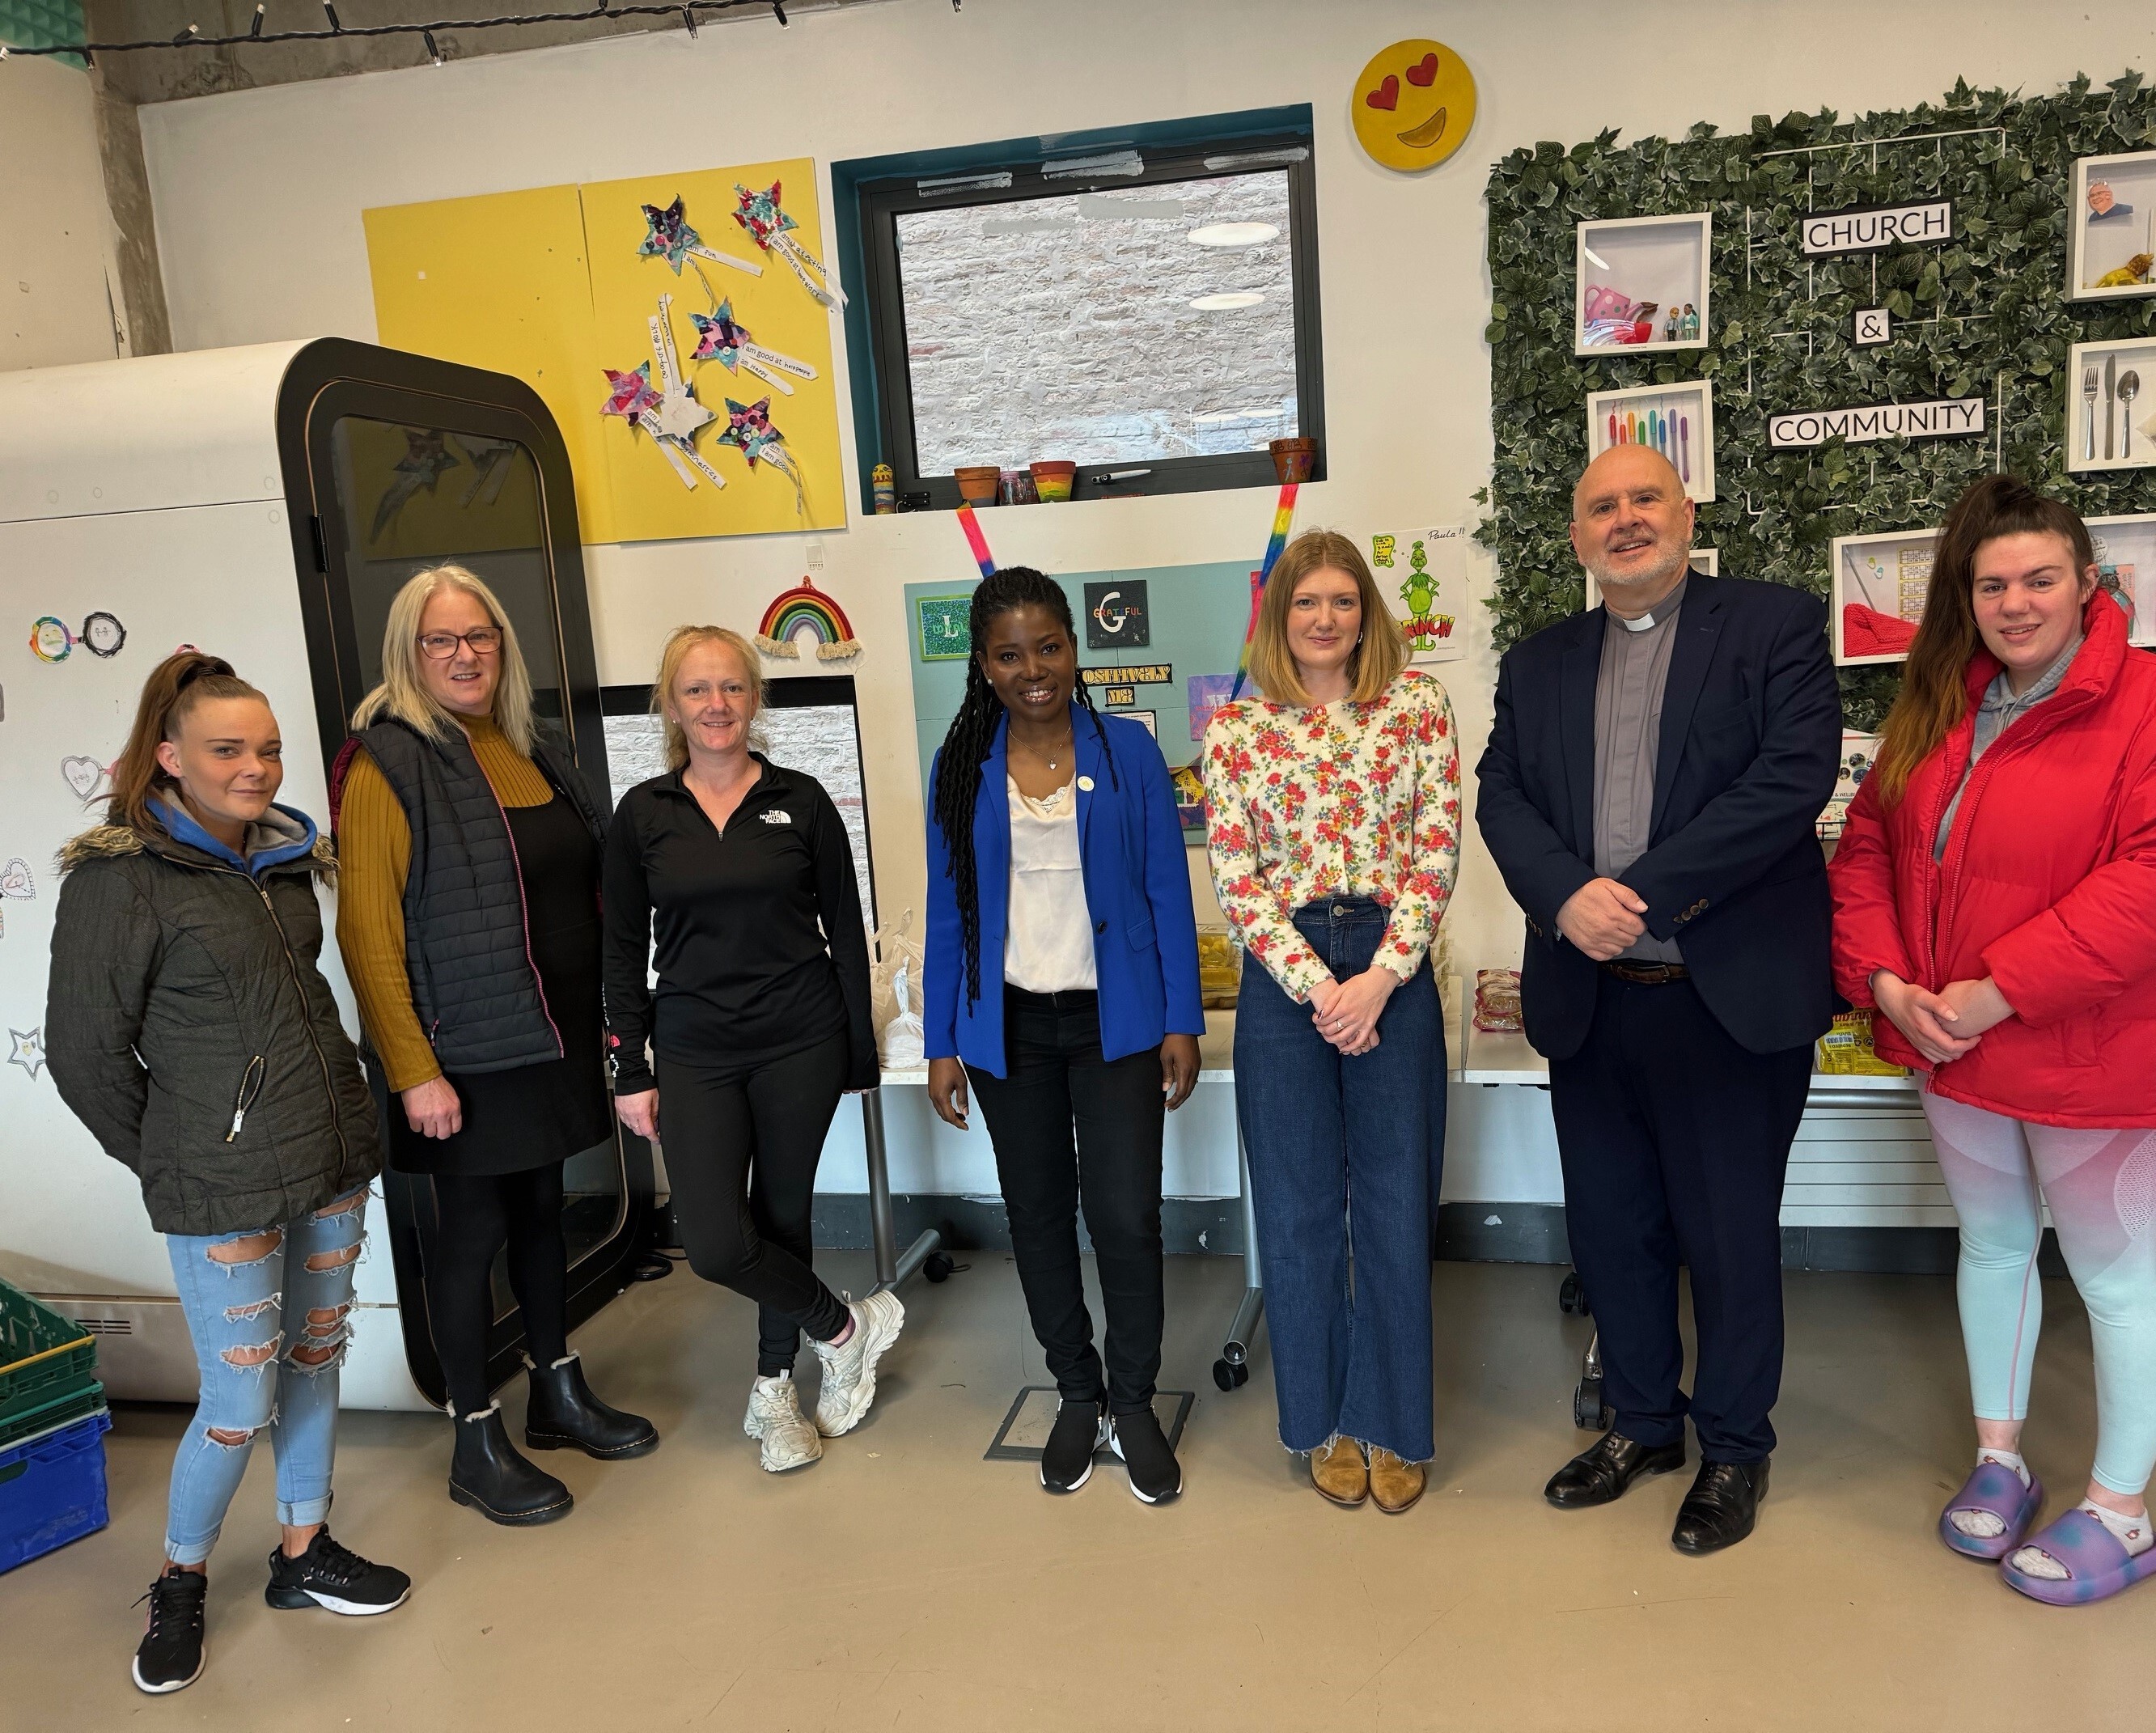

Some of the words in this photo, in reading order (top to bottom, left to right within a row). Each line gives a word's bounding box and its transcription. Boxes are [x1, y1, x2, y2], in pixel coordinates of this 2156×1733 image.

[1808, 209, 1945, 248] CHURCH
[773, 239, 784, 250] am
[782, 249, 794, 263] good
[1861, 315, 1883, 338] &
[745, 346, 756, 354] am
[756, 350, 774, 362] good
[774, 358, 782, 366] at
[1775, 403, 1977, 442] COMMUNITY
[765, 451, 774, 460] am
[1428, 530, 1456, 540] Paula
[1093, 607, 1142, 618] GRATEFUL
[1082, 666, 1171, 684] OSITIVELY
